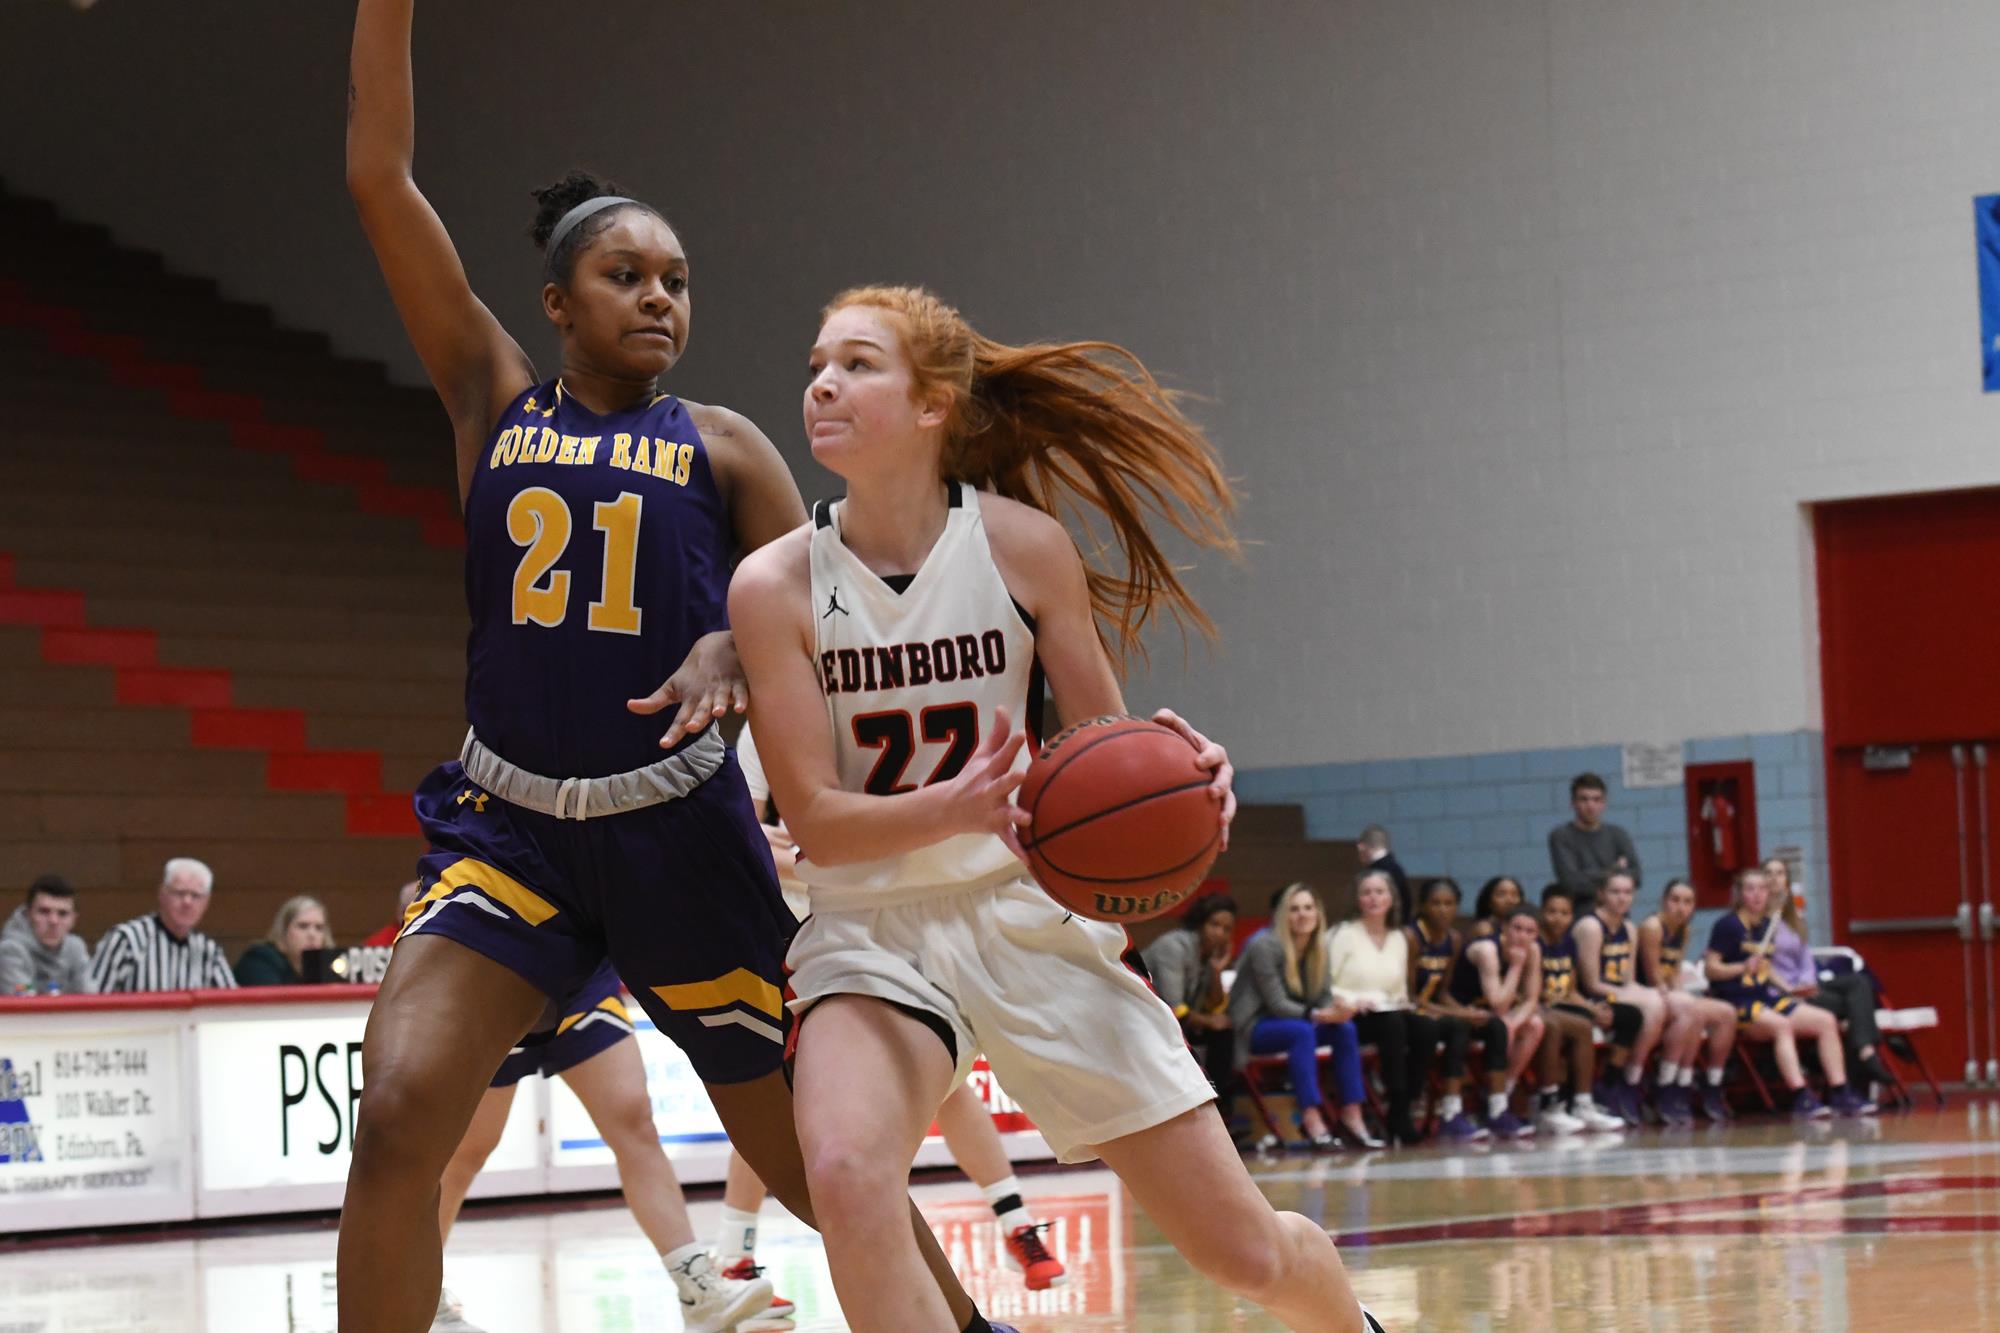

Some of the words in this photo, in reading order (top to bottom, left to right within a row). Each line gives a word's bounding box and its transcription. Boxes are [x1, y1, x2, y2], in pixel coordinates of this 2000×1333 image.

[490, 425, 601, 470] GOLDEN
[609, 433, 694, 487] RAMS
[507, 486, 643, 636] 21
[821, 628, 1006, 696] EDINBORO
[851, 701, 980, 796] 22
